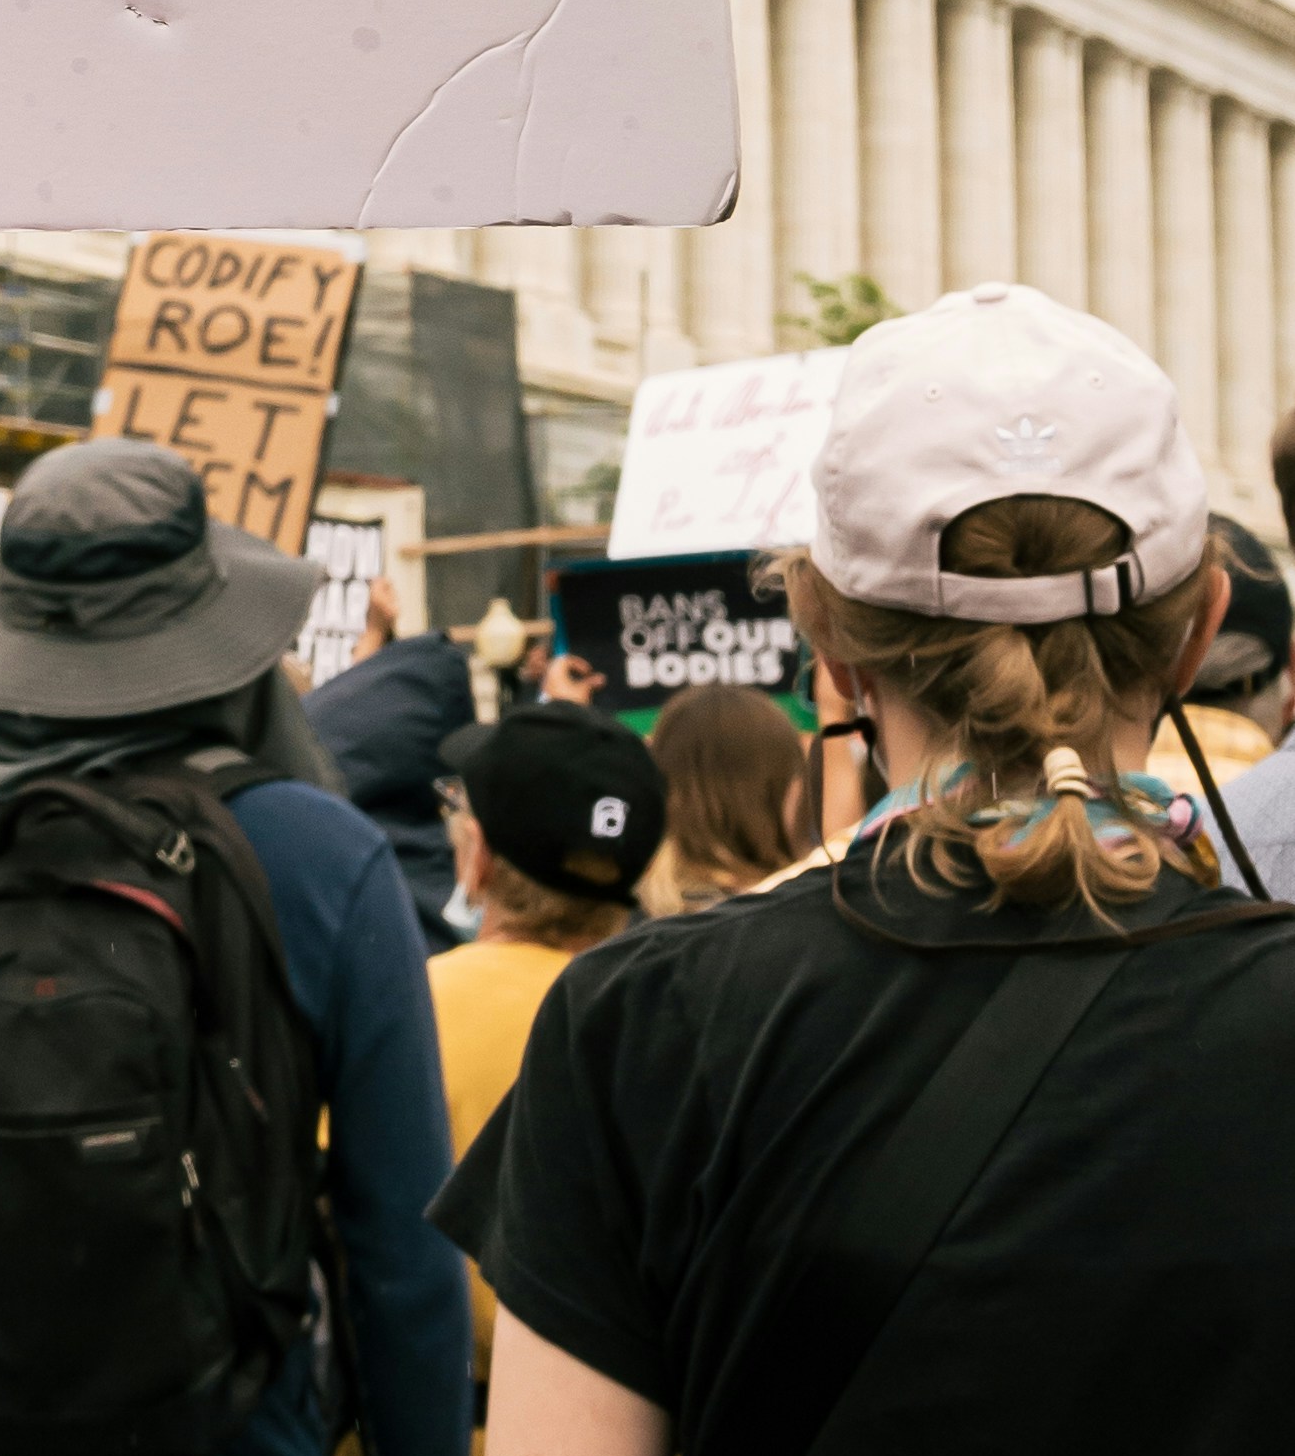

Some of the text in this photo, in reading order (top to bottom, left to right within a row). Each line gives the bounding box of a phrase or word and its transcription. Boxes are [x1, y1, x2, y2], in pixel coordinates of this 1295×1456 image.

[141, 238, 342, 313] CODIFY
[147, 299, 335, 377] ROE!
[120, 386, 301, 462] LET
[619, 589, 728, 627] BANS
[621, 618, 798, 654] OFF OUR
[625, 649, 785, 688] BODIES
